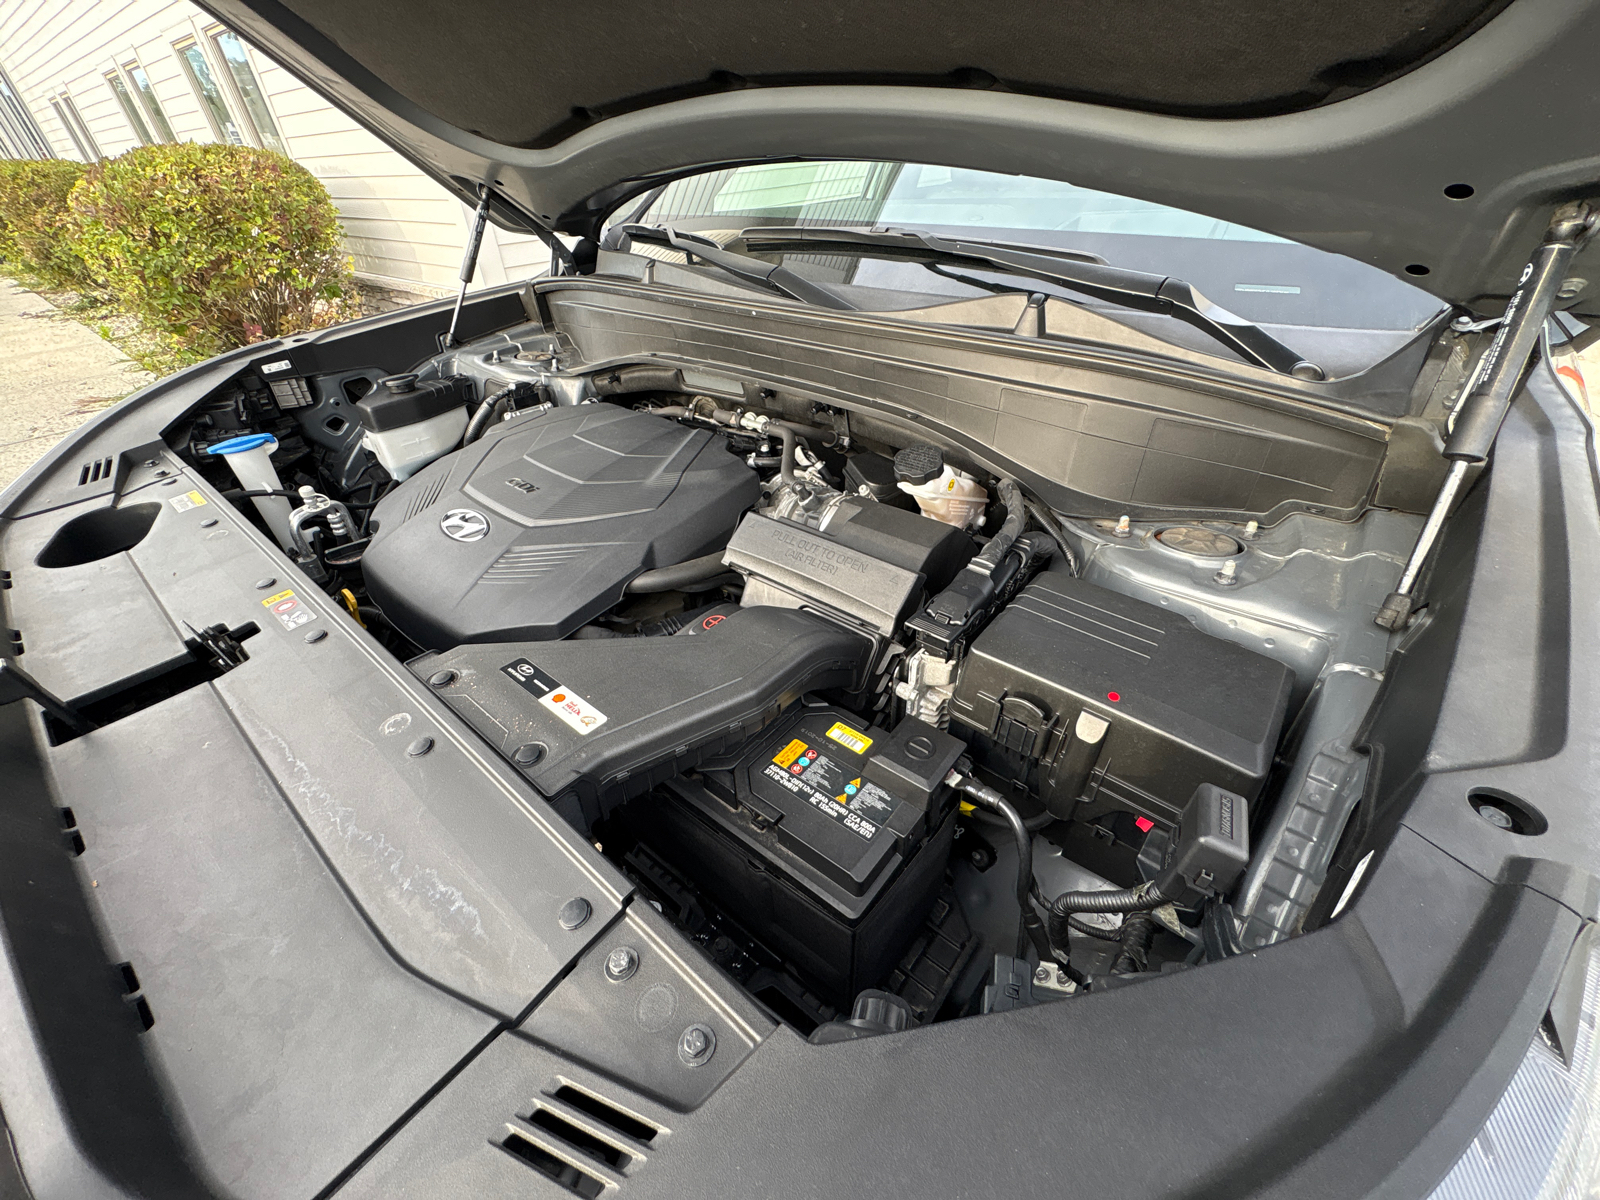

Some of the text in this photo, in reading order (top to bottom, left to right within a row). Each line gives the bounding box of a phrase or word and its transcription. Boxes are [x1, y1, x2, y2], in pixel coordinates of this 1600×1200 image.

[771, 530, 869, 573] PULL OUT TO OPEN
[784, 548, 839, 575] (AIR FILTER)
[809, 796, 820, 805] RC
[848, 813, 861, 824] CCA
